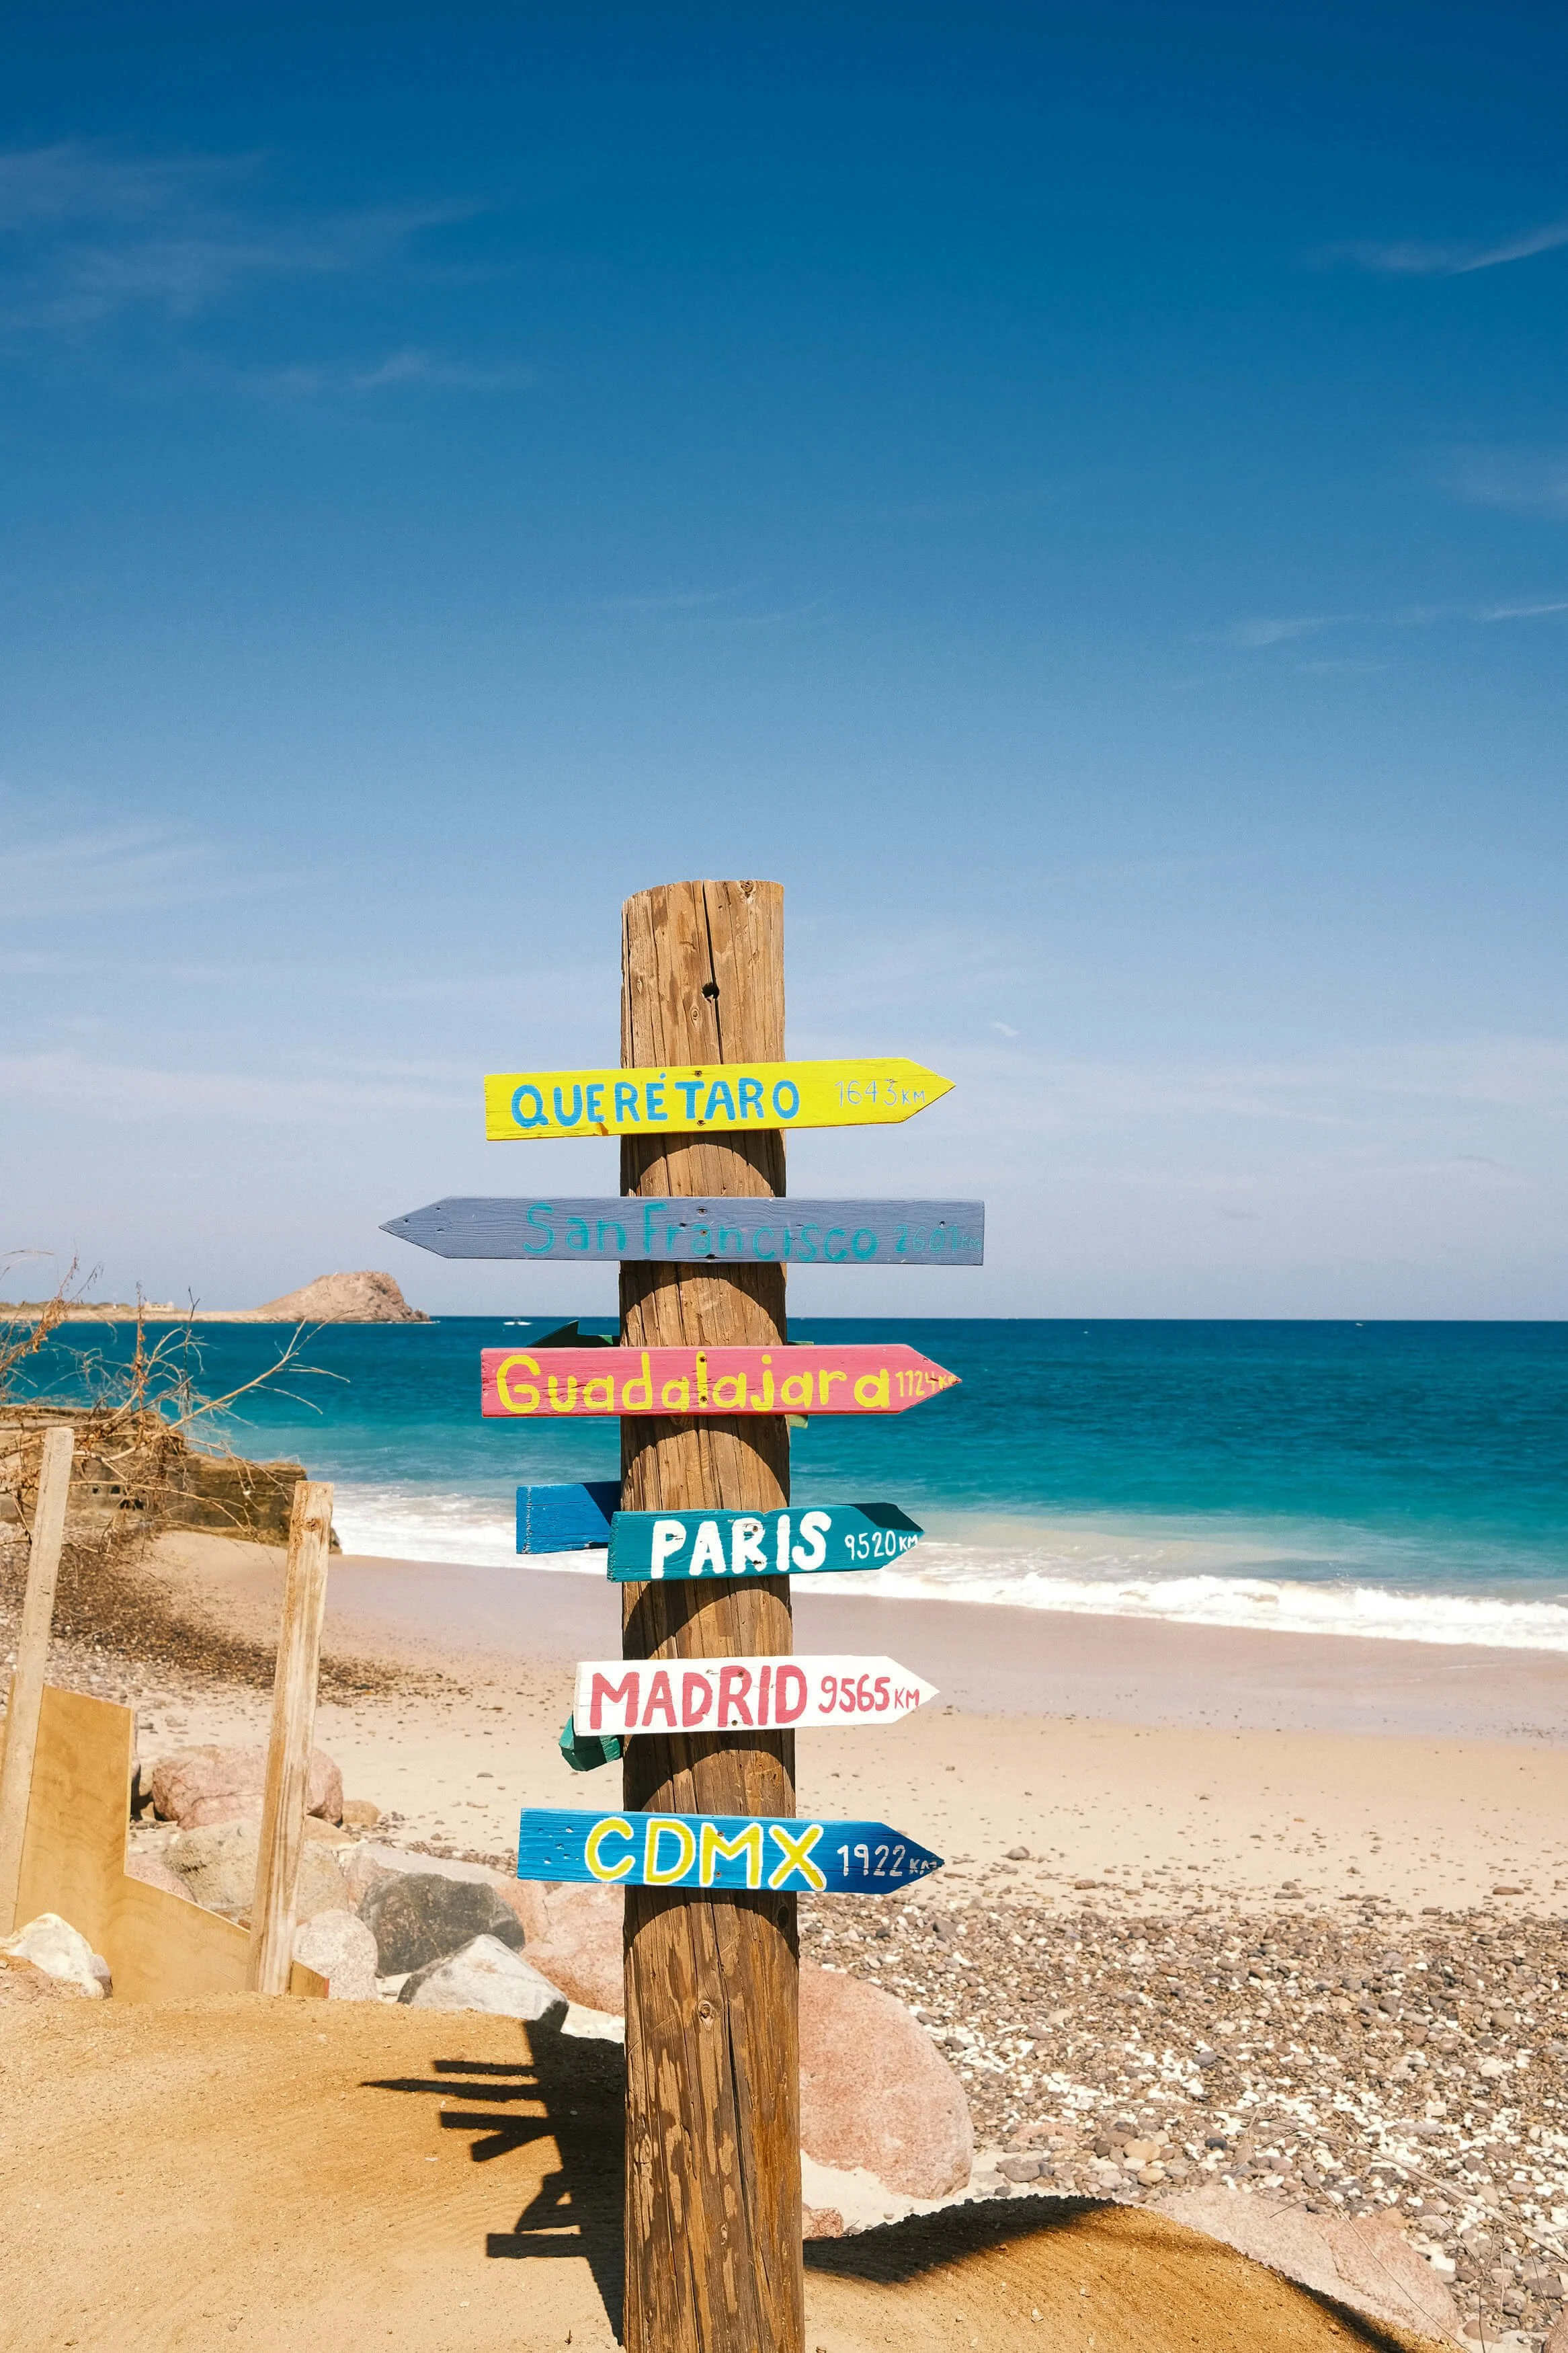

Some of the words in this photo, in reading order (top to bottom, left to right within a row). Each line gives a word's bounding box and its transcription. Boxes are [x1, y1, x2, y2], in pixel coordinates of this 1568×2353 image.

[511, 1072, 800, 1128] QUERÉTARO
[522, 1202, 628, 1254] San
[643, 1202, 879, 1261] Francisco
[496, 1351, 891, 1413] Guadalajara
[650, 1511, 833, 1579] PARIS
[589, 1664, 807, 1730] MADRID
[584, 1817, 827, 1892] CDMX
